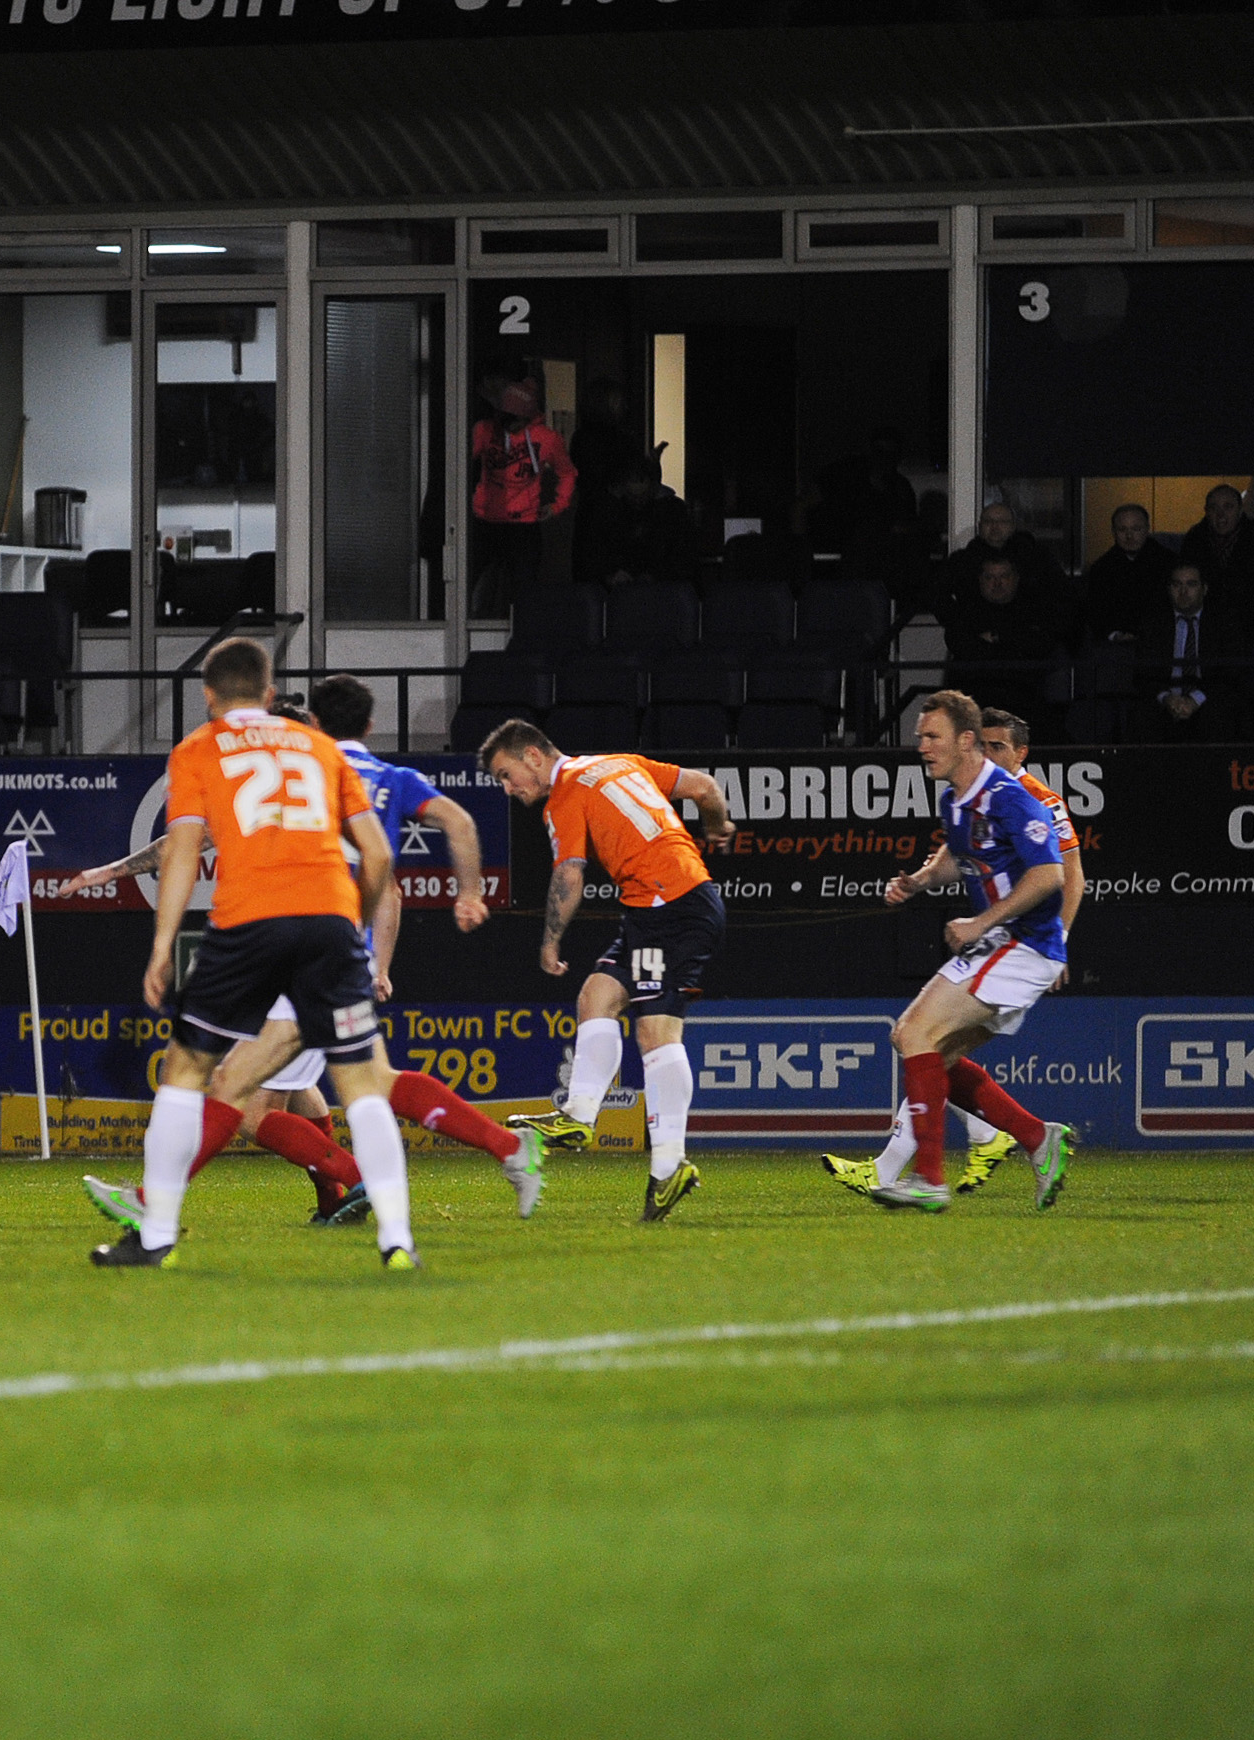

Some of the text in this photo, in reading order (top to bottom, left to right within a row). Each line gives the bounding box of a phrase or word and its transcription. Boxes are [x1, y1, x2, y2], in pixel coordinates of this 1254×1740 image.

[498, 295, 531, 334] 2
[1018, 281, 1051, 322] 3
[219, 750, 329, 837] 23
[440, 770, 472, 788] Ind.
[734, 830, 917, 860] Everything
[1083, 871, 1161, 902] spoke
[631, 947, 666, 981] 14
[18, 1008, 111, 1041] Proud
[402, 1009, 484, 1040] Town
[494, 1008, 533, 1039] FC
[698, 1043, 876, 1089] SKF
[984, 1055, 1123, 1085] skf.co.uk
[13, 1134, 54, 1148] Timbr
[598, 1134, 634, 1147] Glass
